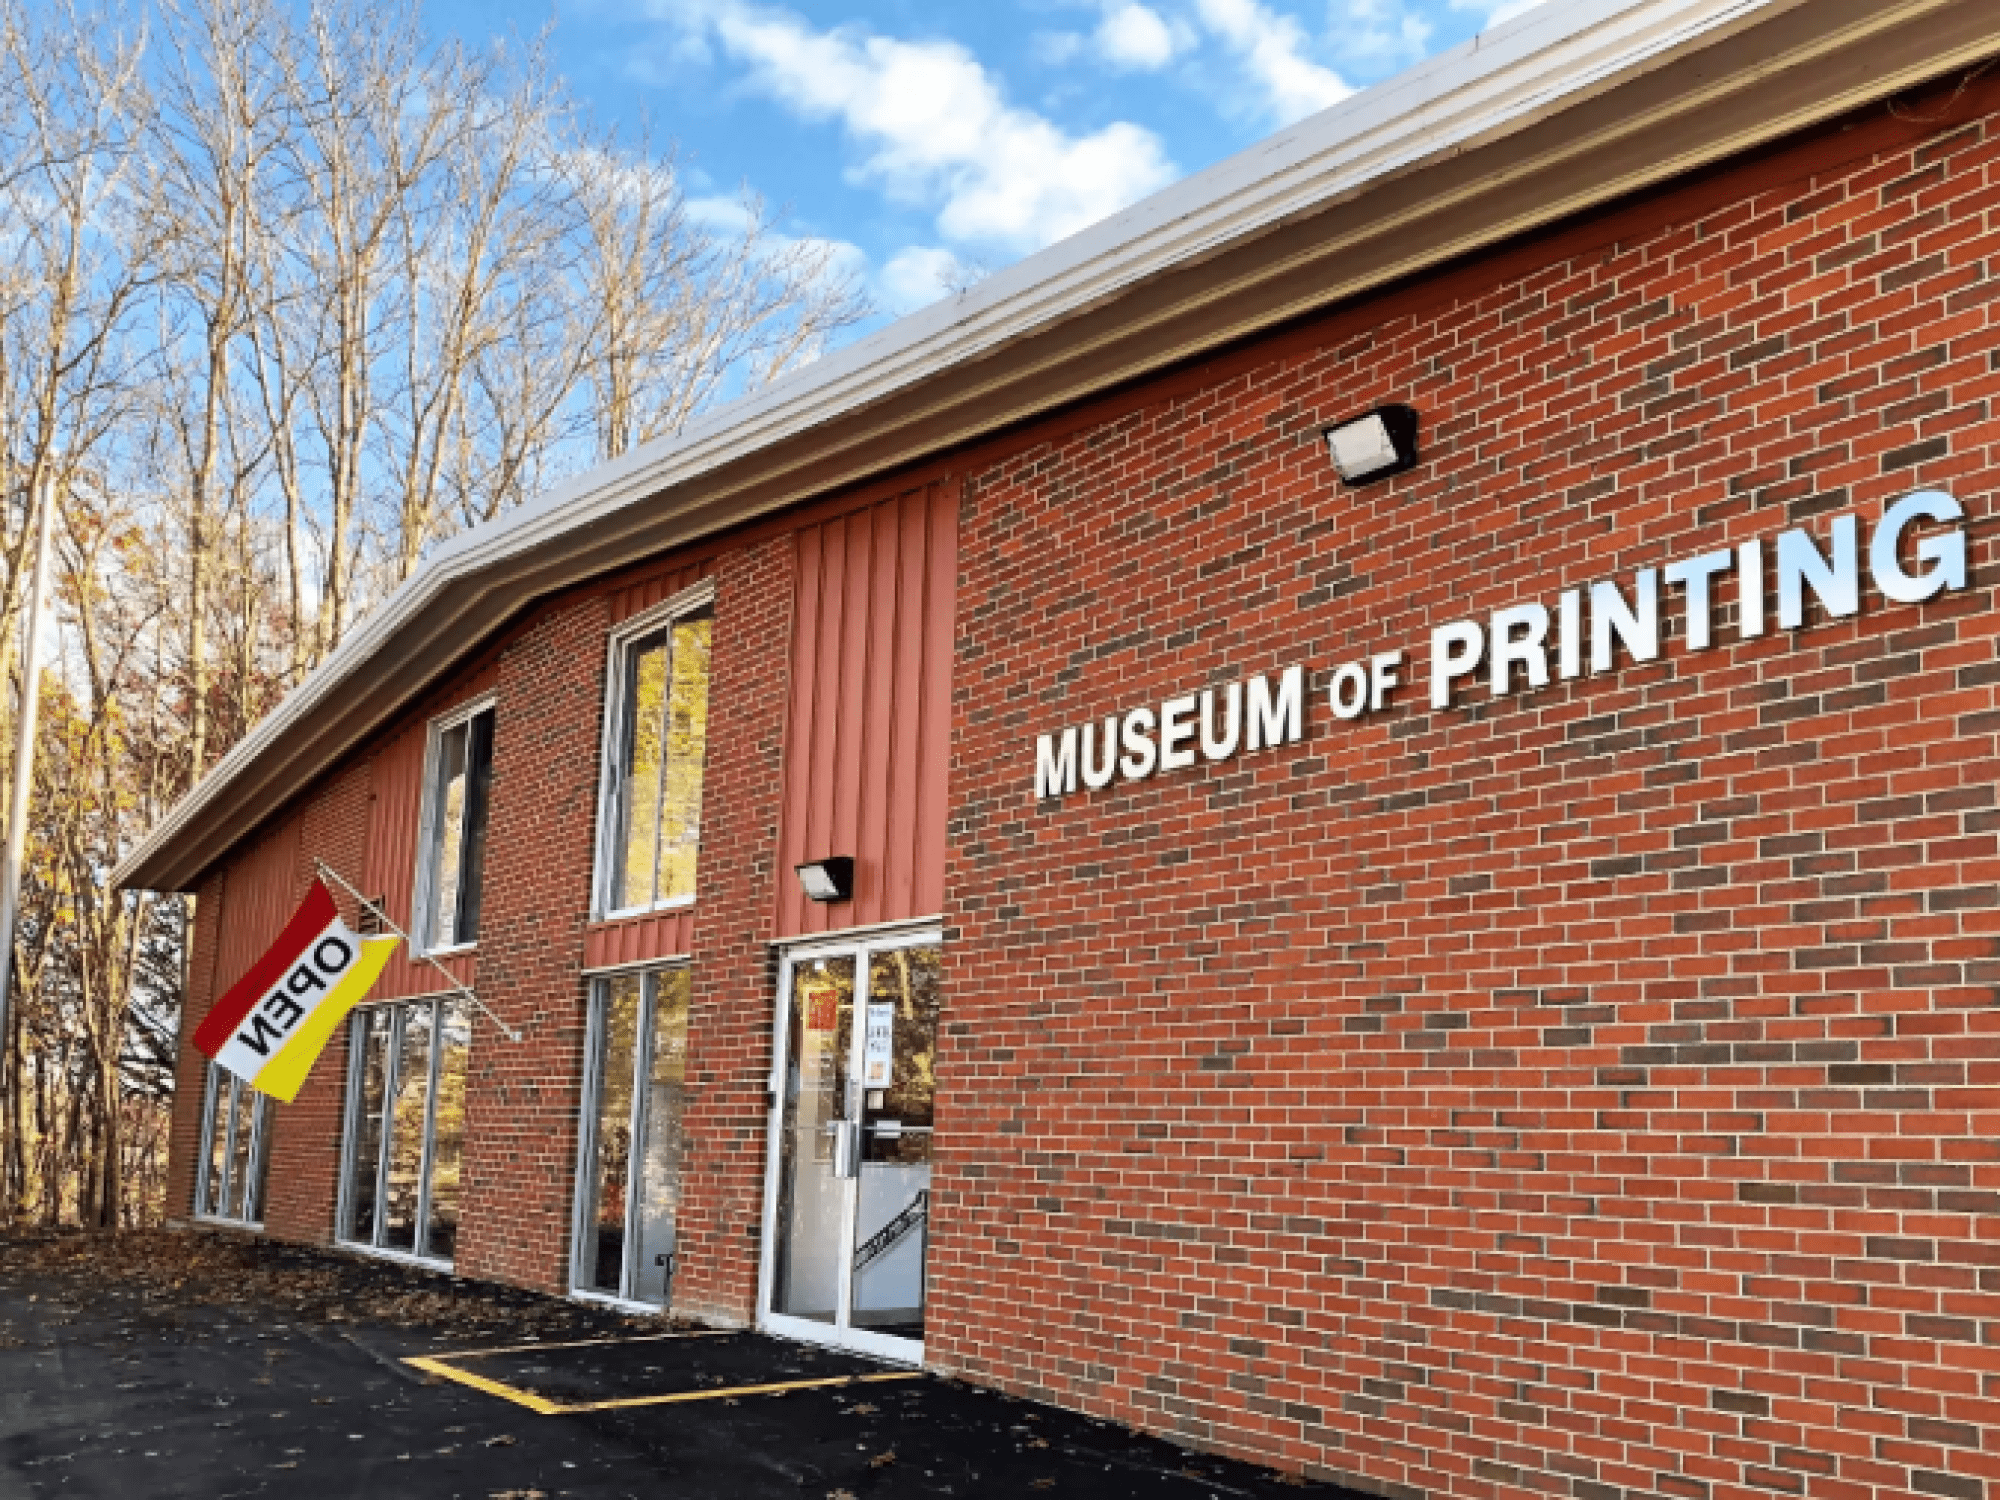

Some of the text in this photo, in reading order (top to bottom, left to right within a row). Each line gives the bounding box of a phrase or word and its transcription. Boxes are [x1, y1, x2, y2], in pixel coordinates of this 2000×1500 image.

[1035, 490, 1968, 799] MUSEUM OF PRINTING
